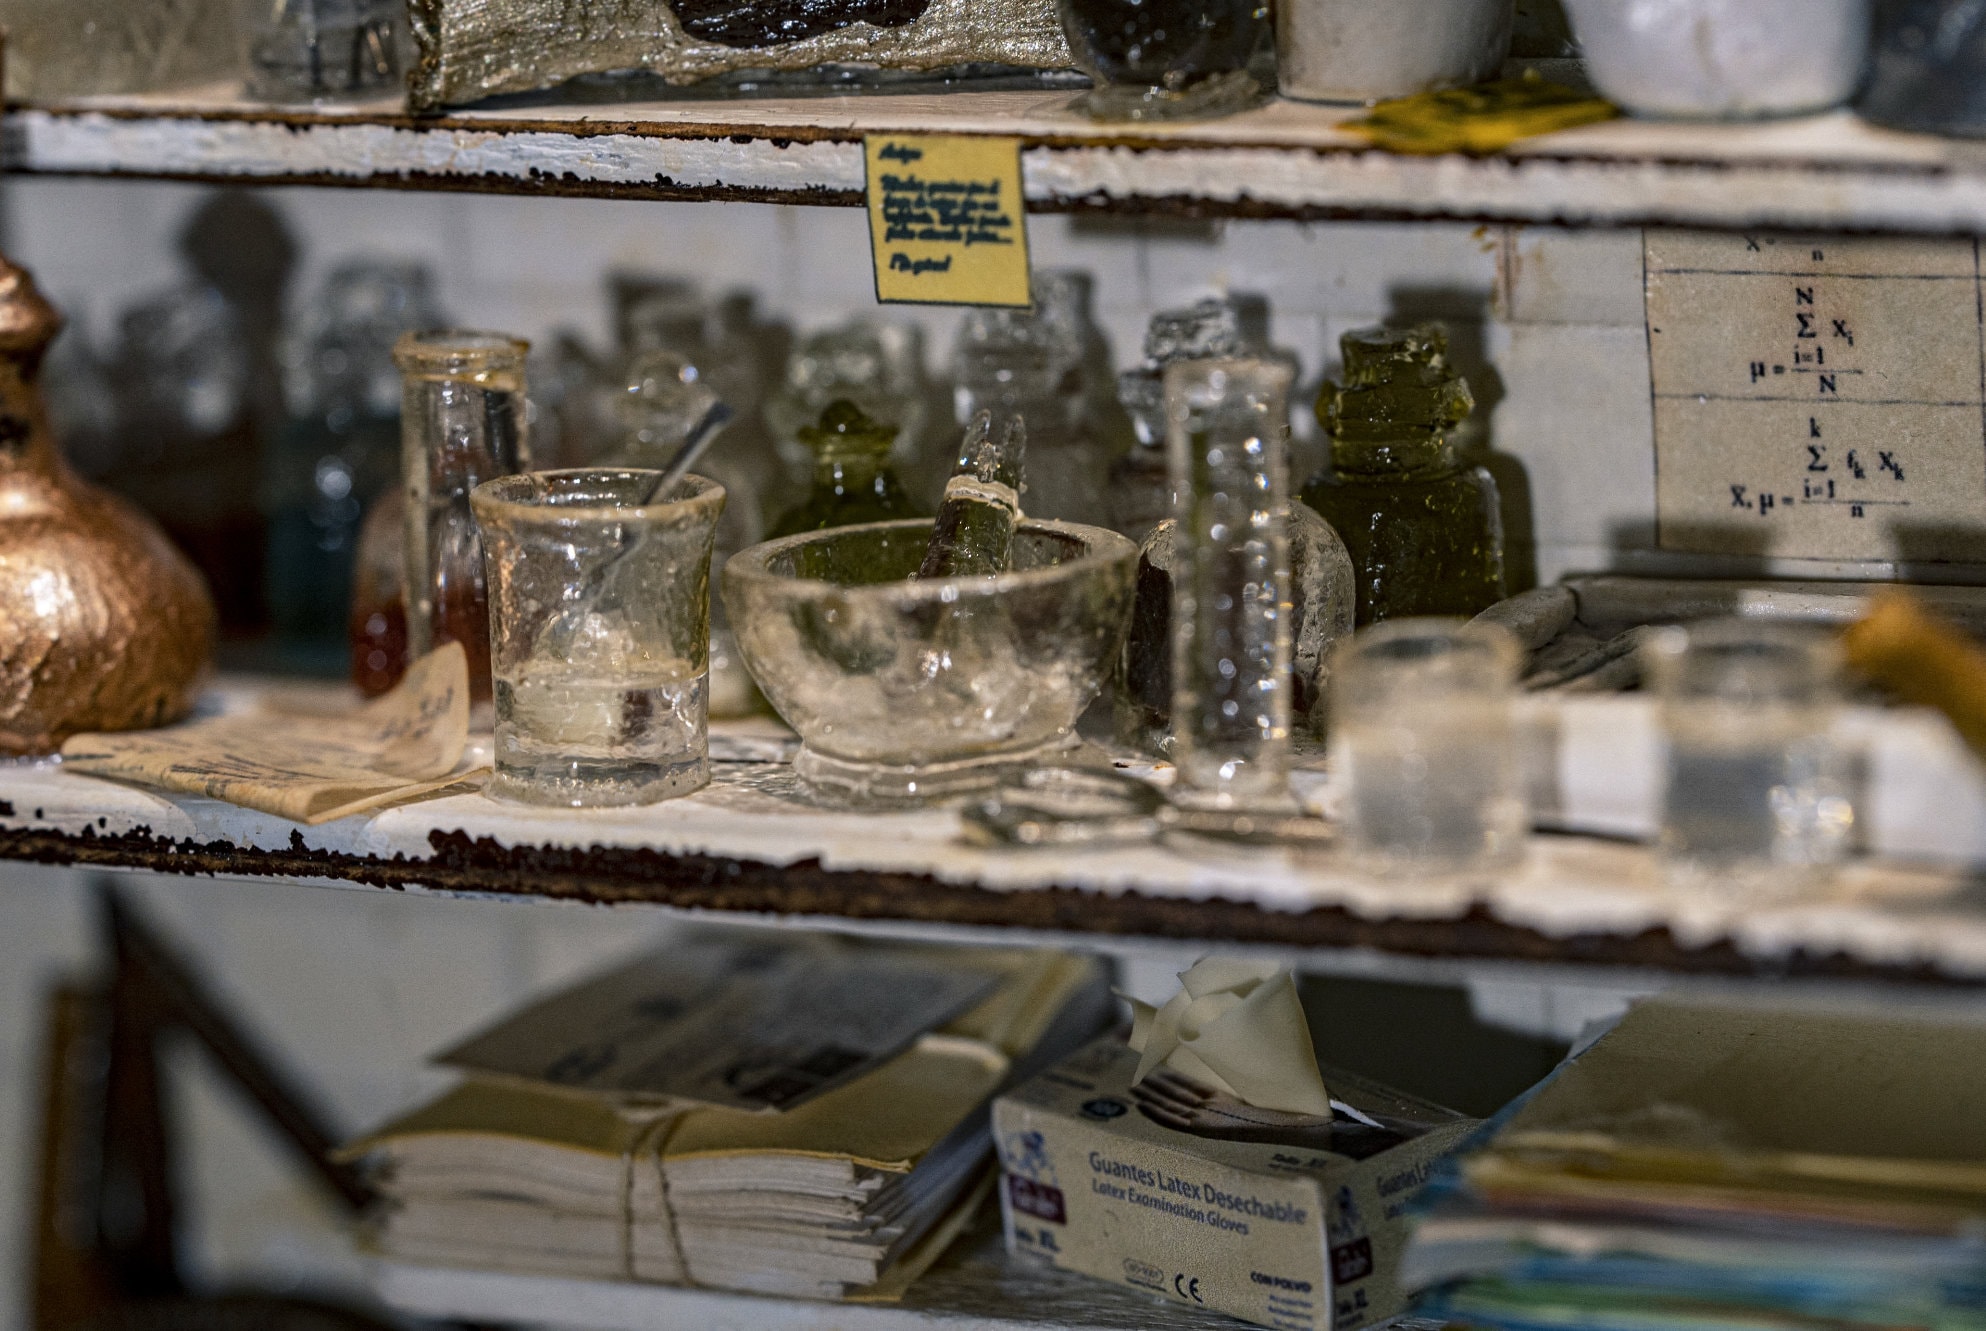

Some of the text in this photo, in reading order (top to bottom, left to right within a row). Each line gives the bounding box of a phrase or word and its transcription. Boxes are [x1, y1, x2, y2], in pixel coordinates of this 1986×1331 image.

[1795, 287, 1813, 305] N
[1819, 374, 1836, 393] N
[1851, 505, 1864, 518] n
[1089, 1152, 1309, 1226] Guantes Latex Desechable
[1092, 1178, 1126, 1200] Latex
[1128, 1186, 1205, 1223] Examination
[1207, 1211, 1249, 1236] Gloves
